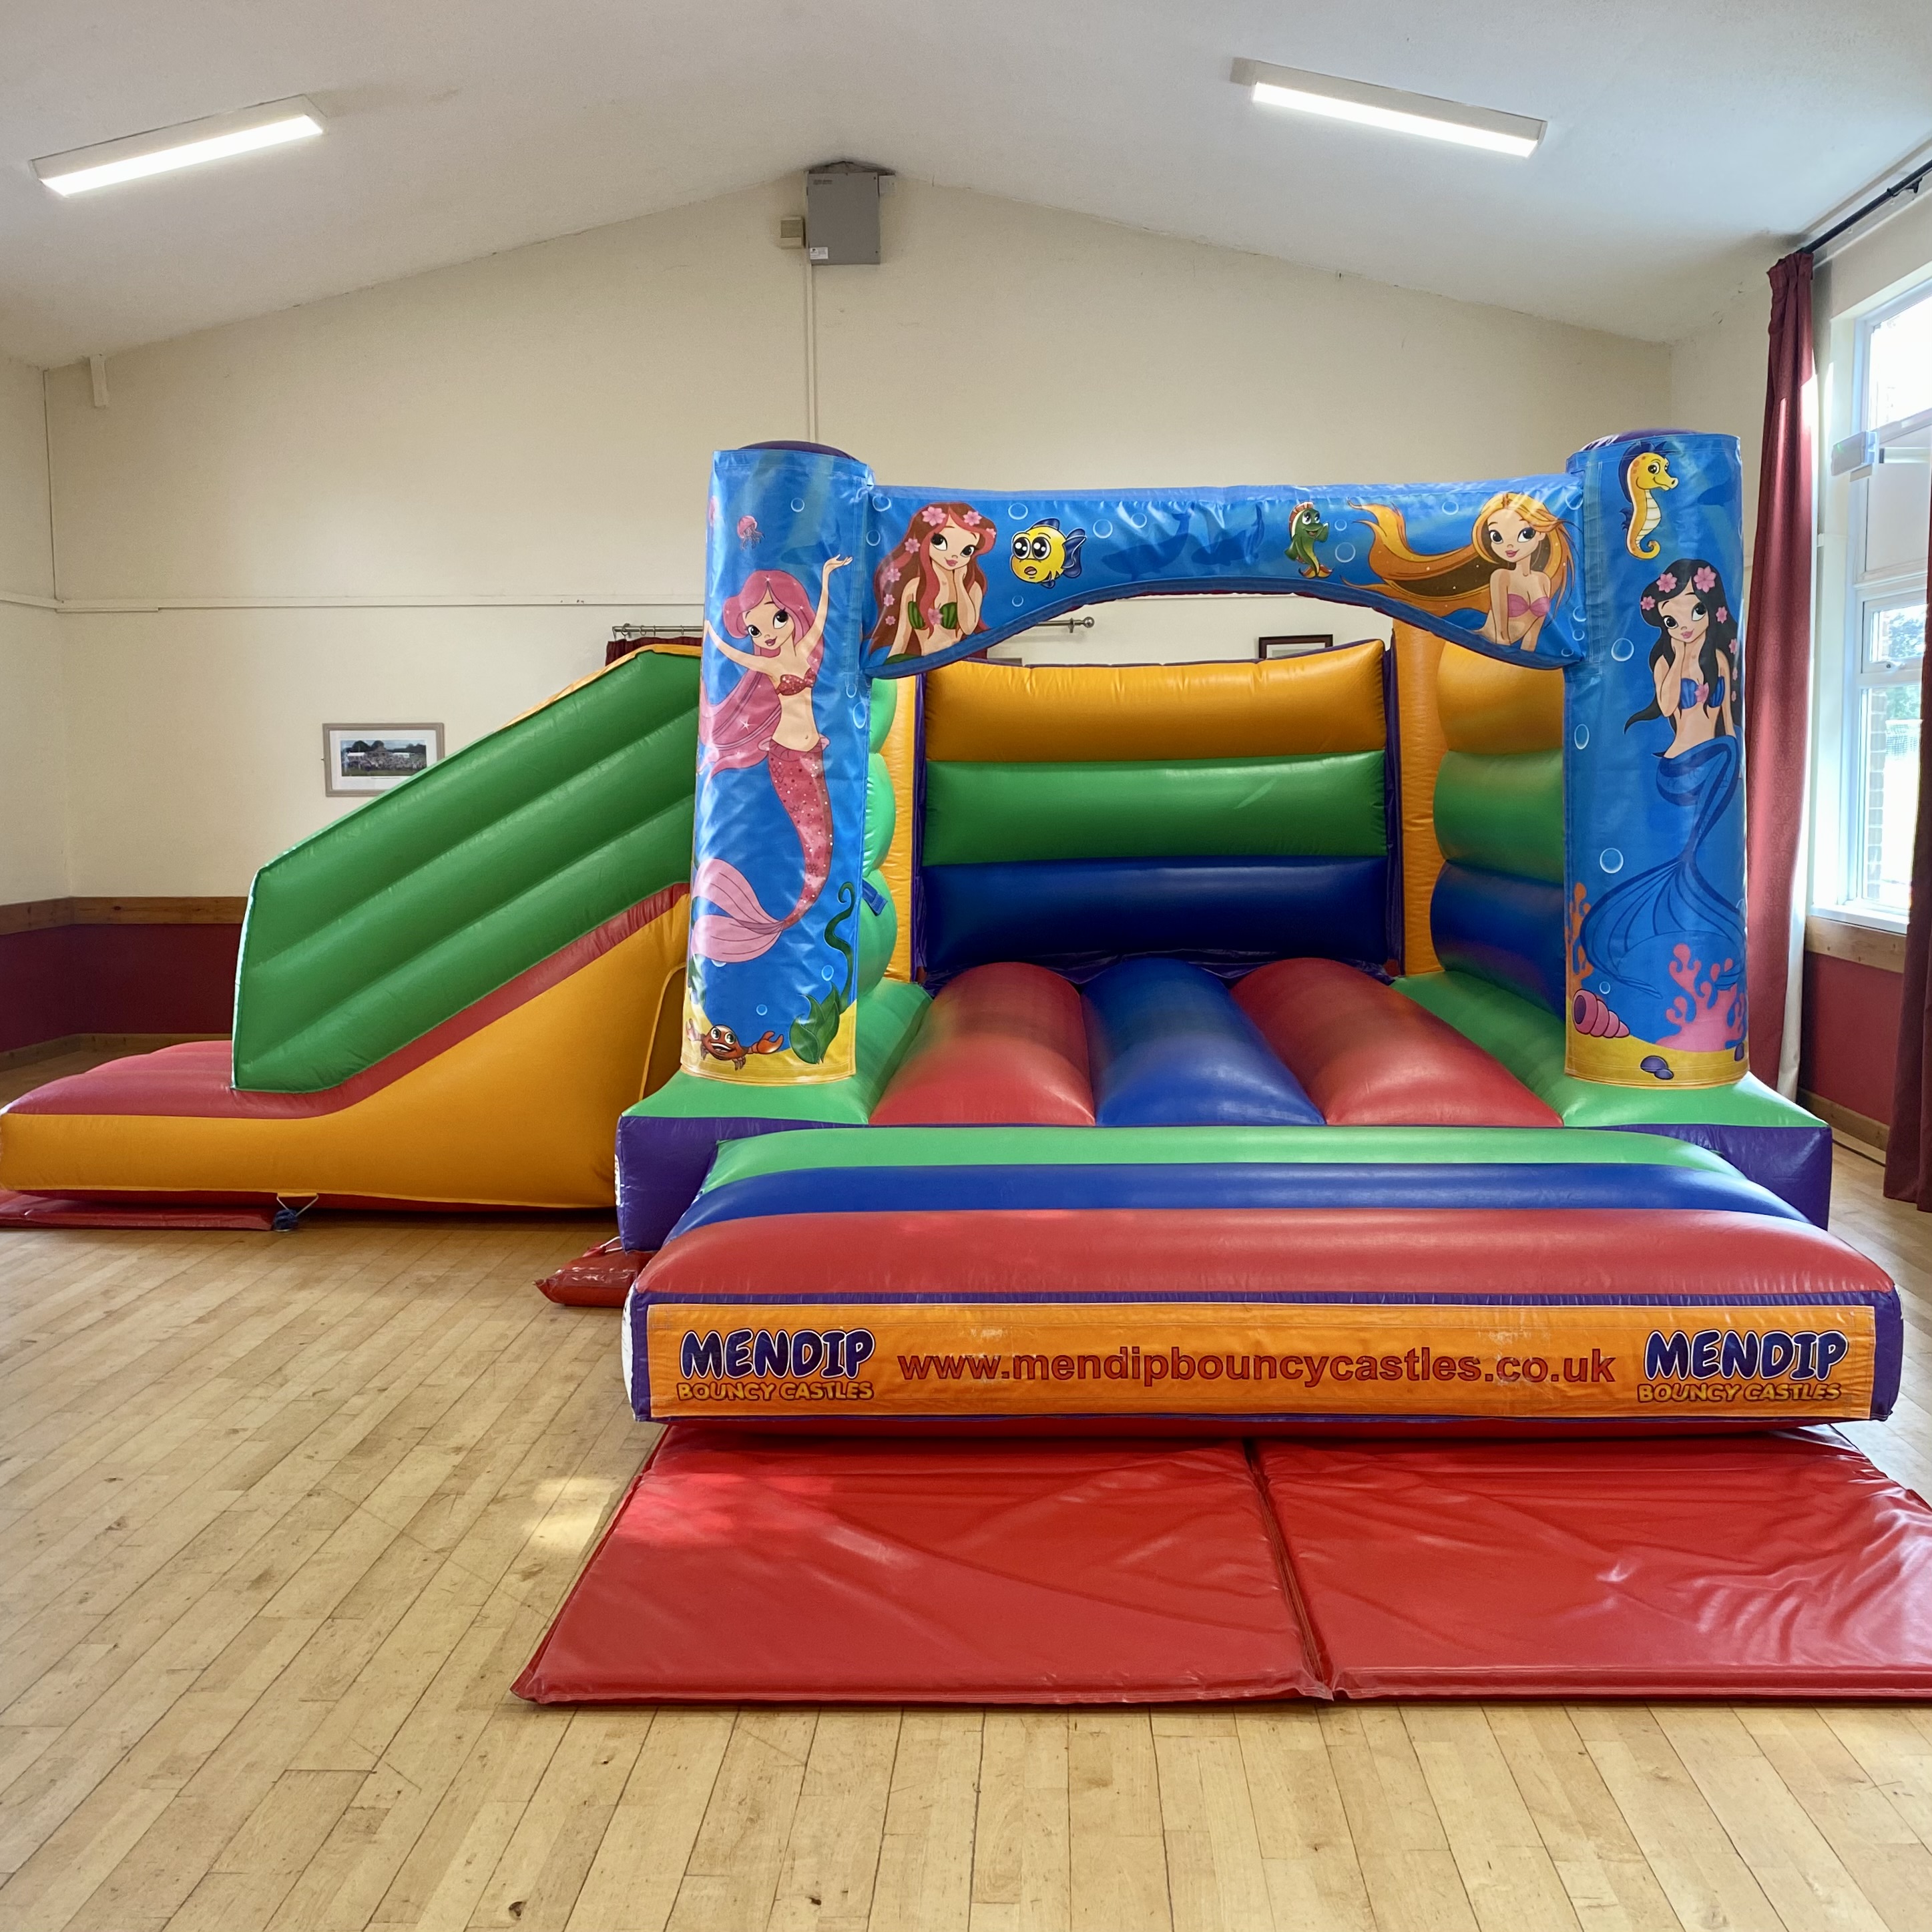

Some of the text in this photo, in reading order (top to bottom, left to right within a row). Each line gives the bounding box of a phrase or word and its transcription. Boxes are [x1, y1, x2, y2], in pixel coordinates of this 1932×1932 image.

[680, 1328, 876, 1380] MENDIP
[897, 1347, 1616, 1387] www.mendipbouncycastles.co.uk
[1644, 1329, 1849, 1381] MENDIP
[676, 1381, 875, 1401] BOUNCY CASTLES
[1637, 1383, 1842, 1403] BOUNCY CASTLES
